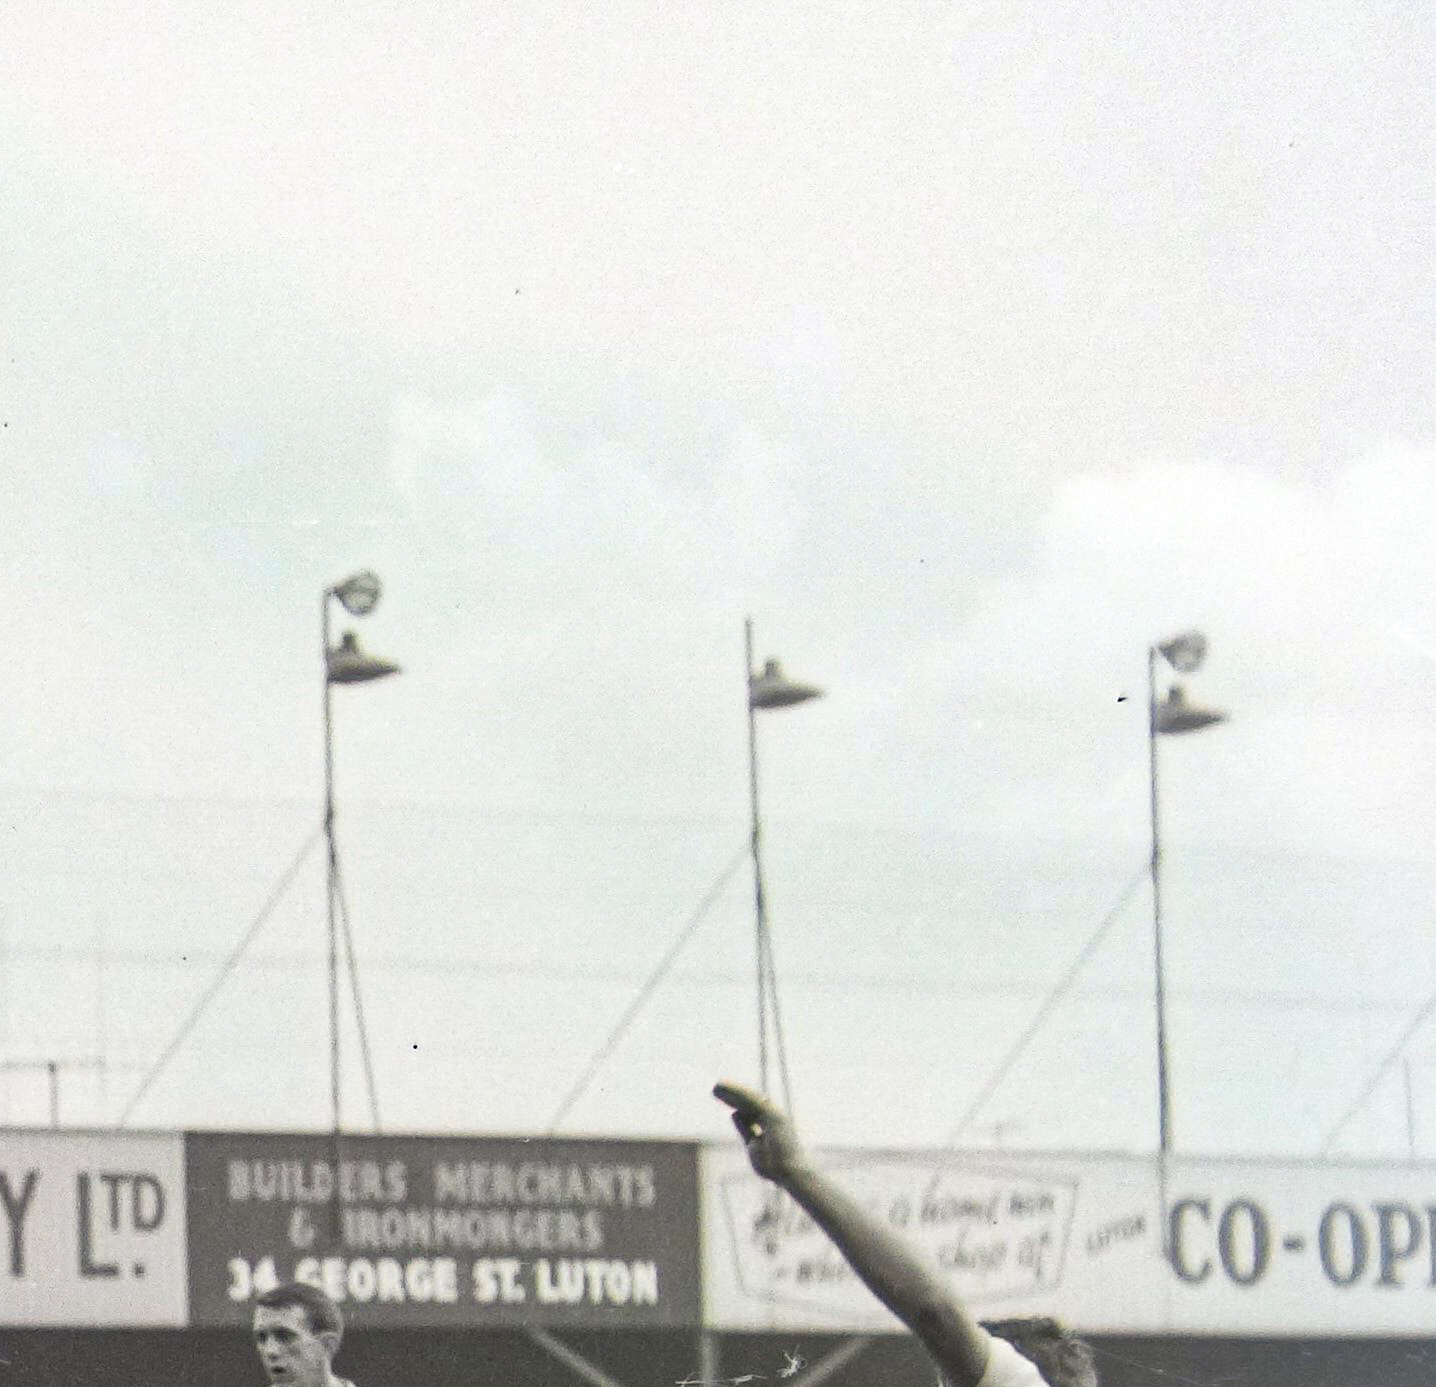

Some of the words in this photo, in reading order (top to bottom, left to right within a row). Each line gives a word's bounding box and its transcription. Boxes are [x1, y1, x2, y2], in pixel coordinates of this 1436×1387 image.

[227, 1159, 408, 1203] BUILDERS
[433, 1162, 656, 1207] MERCHANTS
[342, 1206, 605, 1251] IRONMONGERS
[1168, 1197, 1436, 1288] CO-OP
[534, 1257, 659, 1303] LUTON
